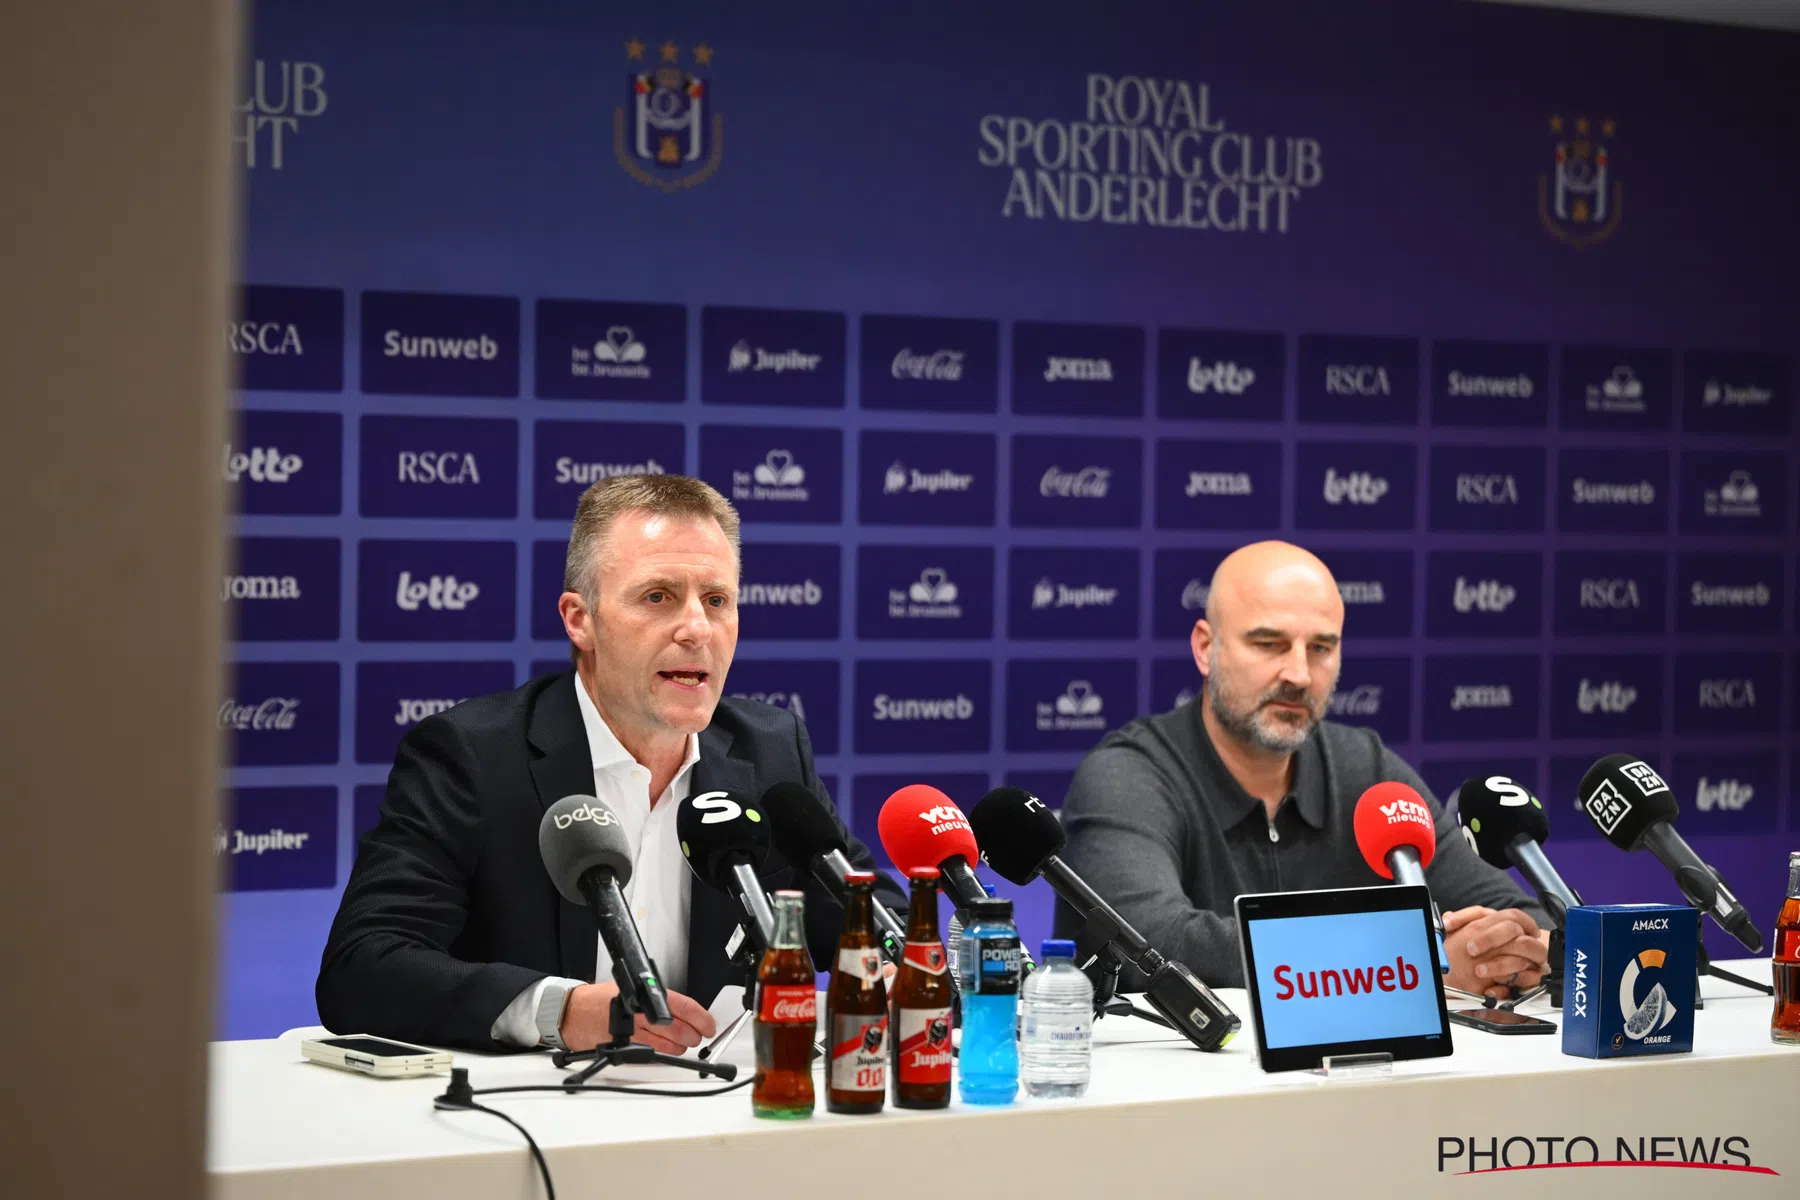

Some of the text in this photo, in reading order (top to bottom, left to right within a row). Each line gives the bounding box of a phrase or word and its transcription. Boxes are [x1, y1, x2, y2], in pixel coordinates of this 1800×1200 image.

[1087, 73, 1224, 132] ROYAL
[979, 115, 1322, 186] SPORTING CLUB
[1002, 168, 1300, 233] ANDERLECHT
[385, 331, 497, 360] Sunweb
[754, 348, 820, 372] Jupiler
[1326, 366, 1389, 394] RSCA
[1449, 372, 1533, 397] Sunweb
[399, 452, 479, 483] RSCA
[910, 470, 972, 493] Jupiler
[1457, 475, 1517, 503] RSCA
[1574, 479, 1654, 503] Sunweb
[738, 580, 822, 605] unweb
[1058, 585, 1116, 607] Jupiler
[1581, 580, 1639, 607] RSCA
[1692, 582, 1769, 605] Sunweb
[1700, 680, 1755, 707] RSCA
[874, 695, 973, 719] Sunweb
[553, 803, 620, 830] belga
[1379, 799, 1429, 822] vtm
[1387, 812, 1431, 829] nieuws
[931, 820, 974, 836] nieuw
[232, 829, 308, 854] Jupiler
[1632, 918, 1669, 931] AMACX
[1273, 955, 1419, 1000] Sunweb
[1575, 949, 1588, 1017] AMACX
[1643, 1035, 1671, 1044] ORANGE
